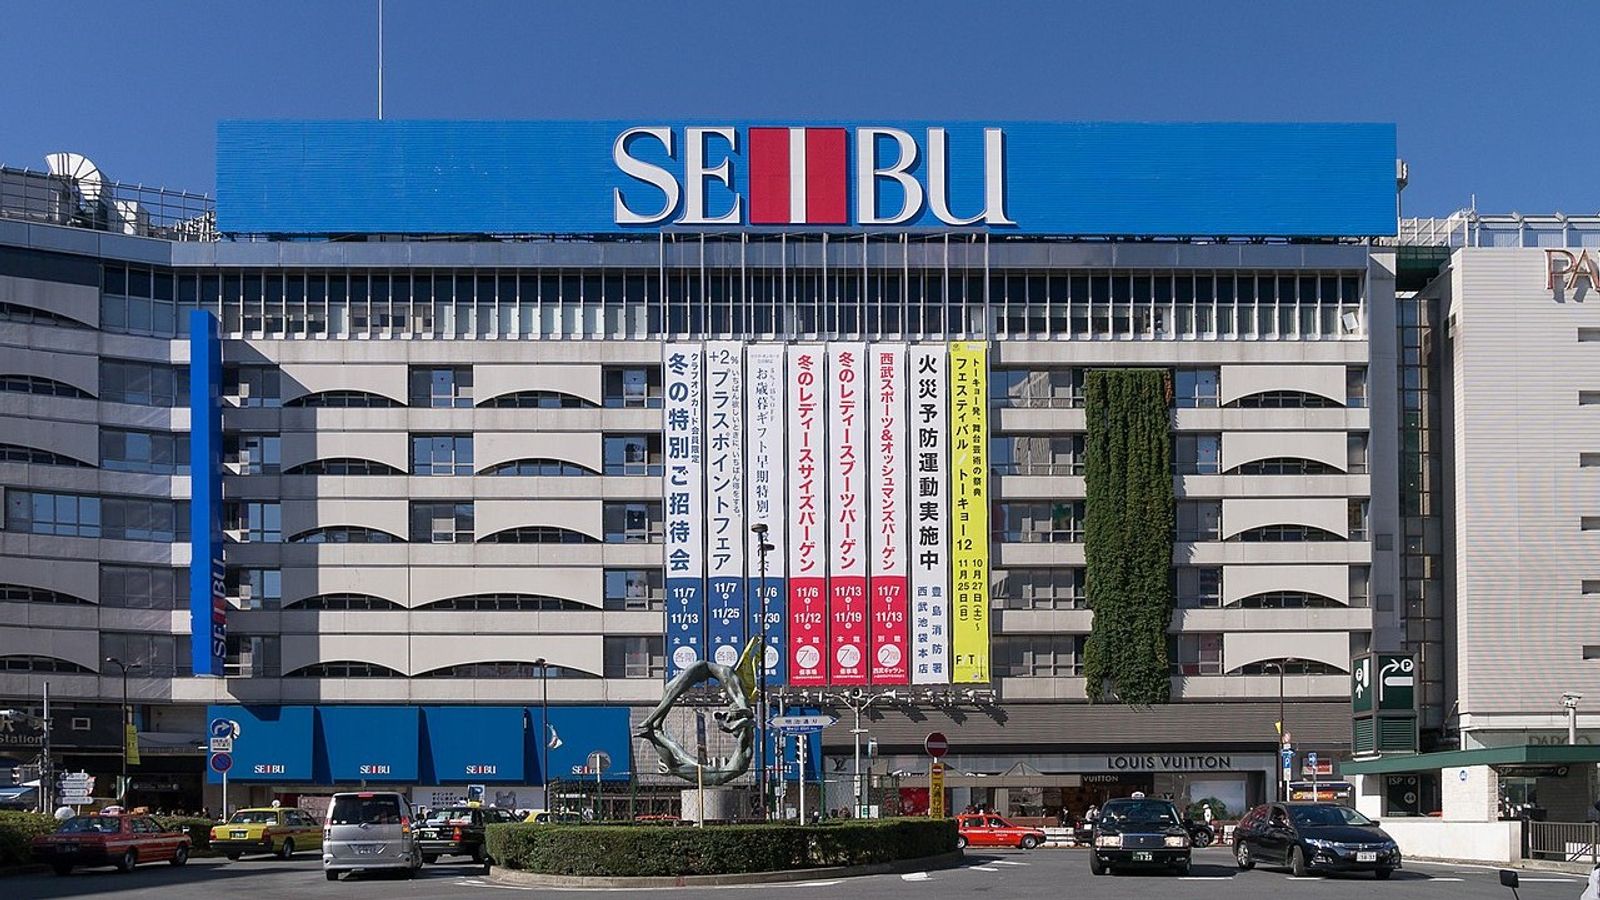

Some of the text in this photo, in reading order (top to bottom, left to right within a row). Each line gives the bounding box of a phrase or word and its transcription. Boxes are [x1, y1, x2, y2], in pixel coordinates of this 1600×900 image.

[612, 126, 1017, 225] SEIBU
[1544, 248, 1600, 291] PA
[668, 352, 690, 571] 冬の特別ご招待会
[797, 354, 817, 572] 冬のレディースサイズバーゲン
[838, 351, 856, 570] 冬のレディースブーツバーゲン
[879, 352, 897, 570] 西武スポーツ&オッシュマンズバーゲン
[918, 354, 939, 571] 火災予防運動実施中
[712, 367, 732, 570] プラスポイントフェア
[673, 587, 696, 598] 11/7
[714, 582, 737, 593] 11/7
[755, 587, 778, 597] 1/6
[796, 587, 819, 597] 11/6
[834, 586, 862, 596] 11/13
[877, 586, 900, 596] 11/7
[212, 558, 227, 658] SEIBU
[712, 608, 740, 619] 11/25
[671, 613, 699, 624] 11/13
[794, 613, 822, 624] 11/12
[834, 612, 862, 622] 11/19
[875, 612, 903, 622] 11/13
[917, 586, 929, 674] 西武池袋本店
[931, 586, 943, 674] 豊島消防署
[1107, 756, 1231, 769] LOUIS VUITTON
[254, 765, 285, 774] SEIBU
[360, 765, 390, 774] SEIBU
[466, 765, 496, 774] SEIBU
[1083, 775, 1119, 783] VUITTON
